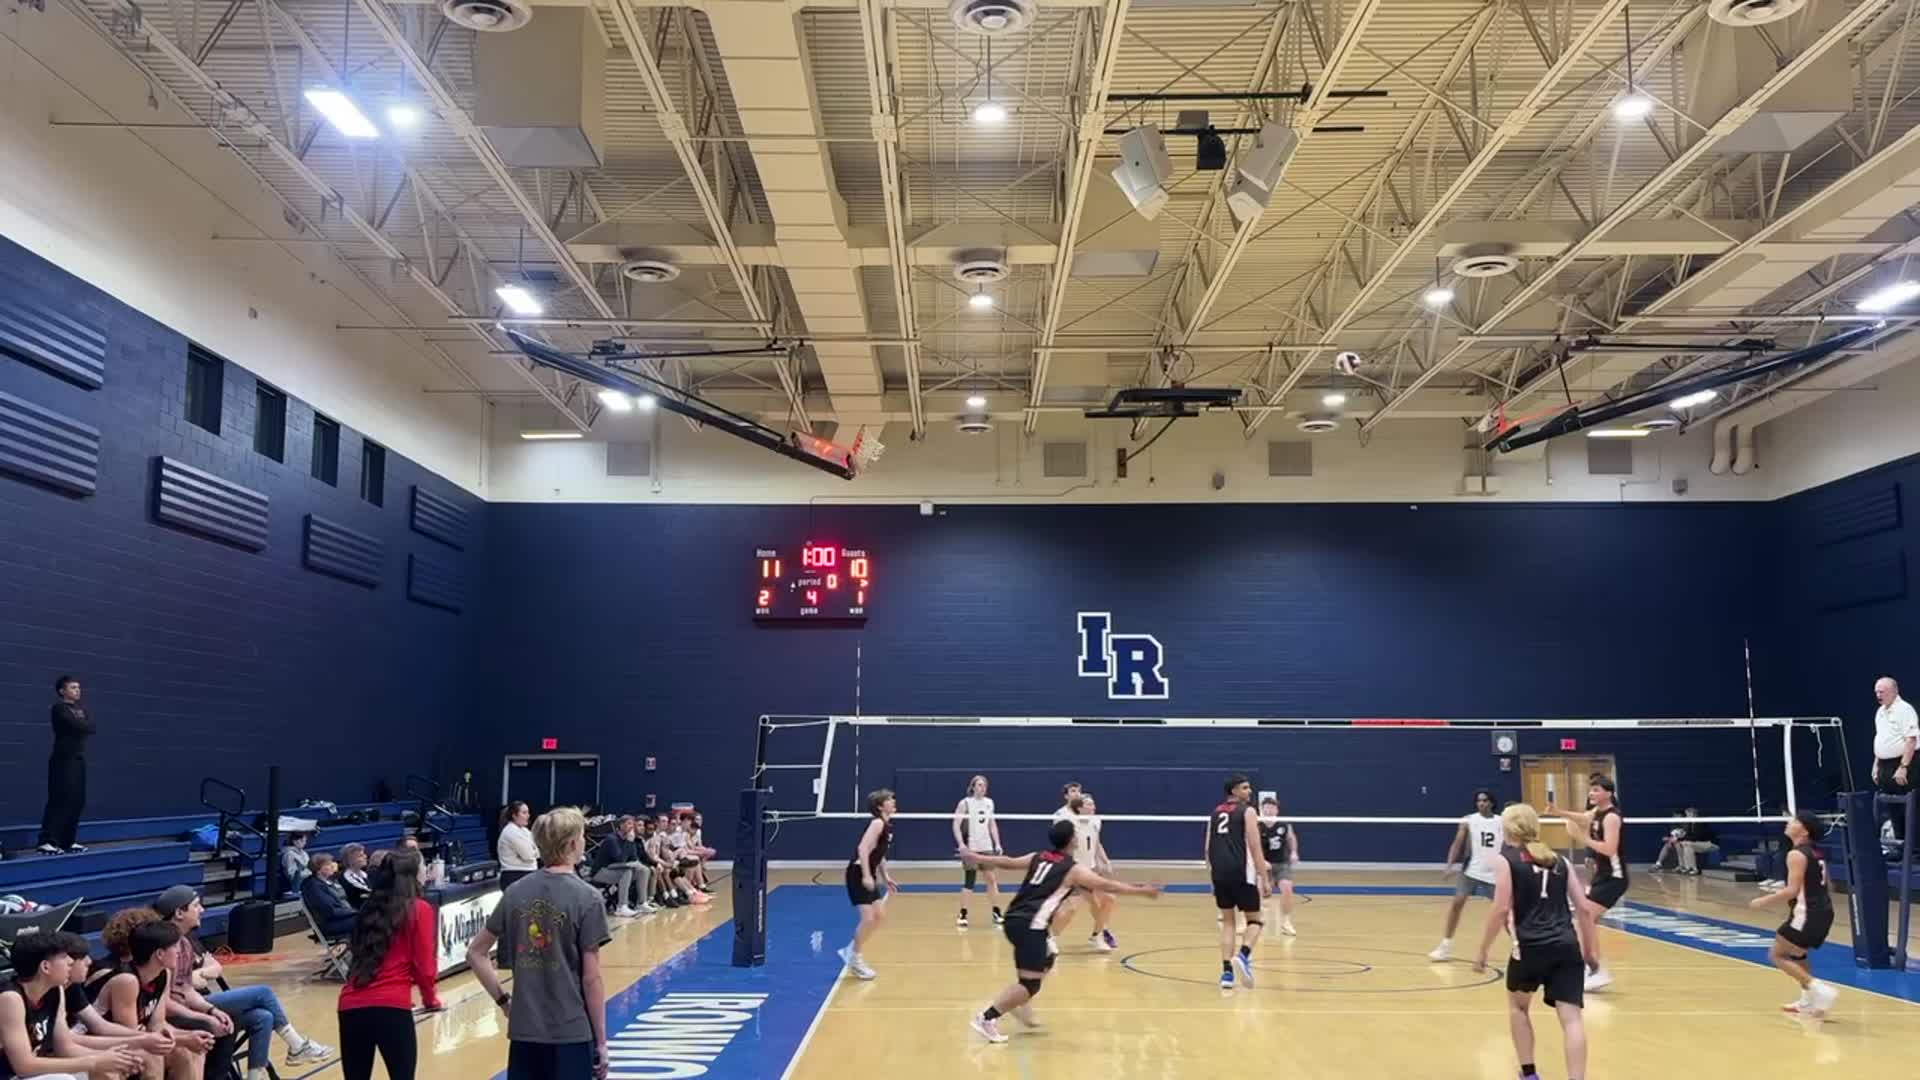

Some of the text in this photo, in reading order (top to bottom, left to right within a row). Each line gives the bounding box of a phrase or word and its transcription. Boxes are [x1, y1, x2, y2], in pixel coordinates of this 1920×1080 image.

[803, 547, 835, 566] 1:00
[763, 559, 780, 578] 11
[850, 558, 867, 578] 10
[826, 573, 837, 589] 0
[758, 590, 769, 606] 2
[806, 590, 817, 605] 4
[857, 590, 863, 605] 1
[1217, 812, 1230, 834] 2
[1480, 831, 1495, 848] 12
